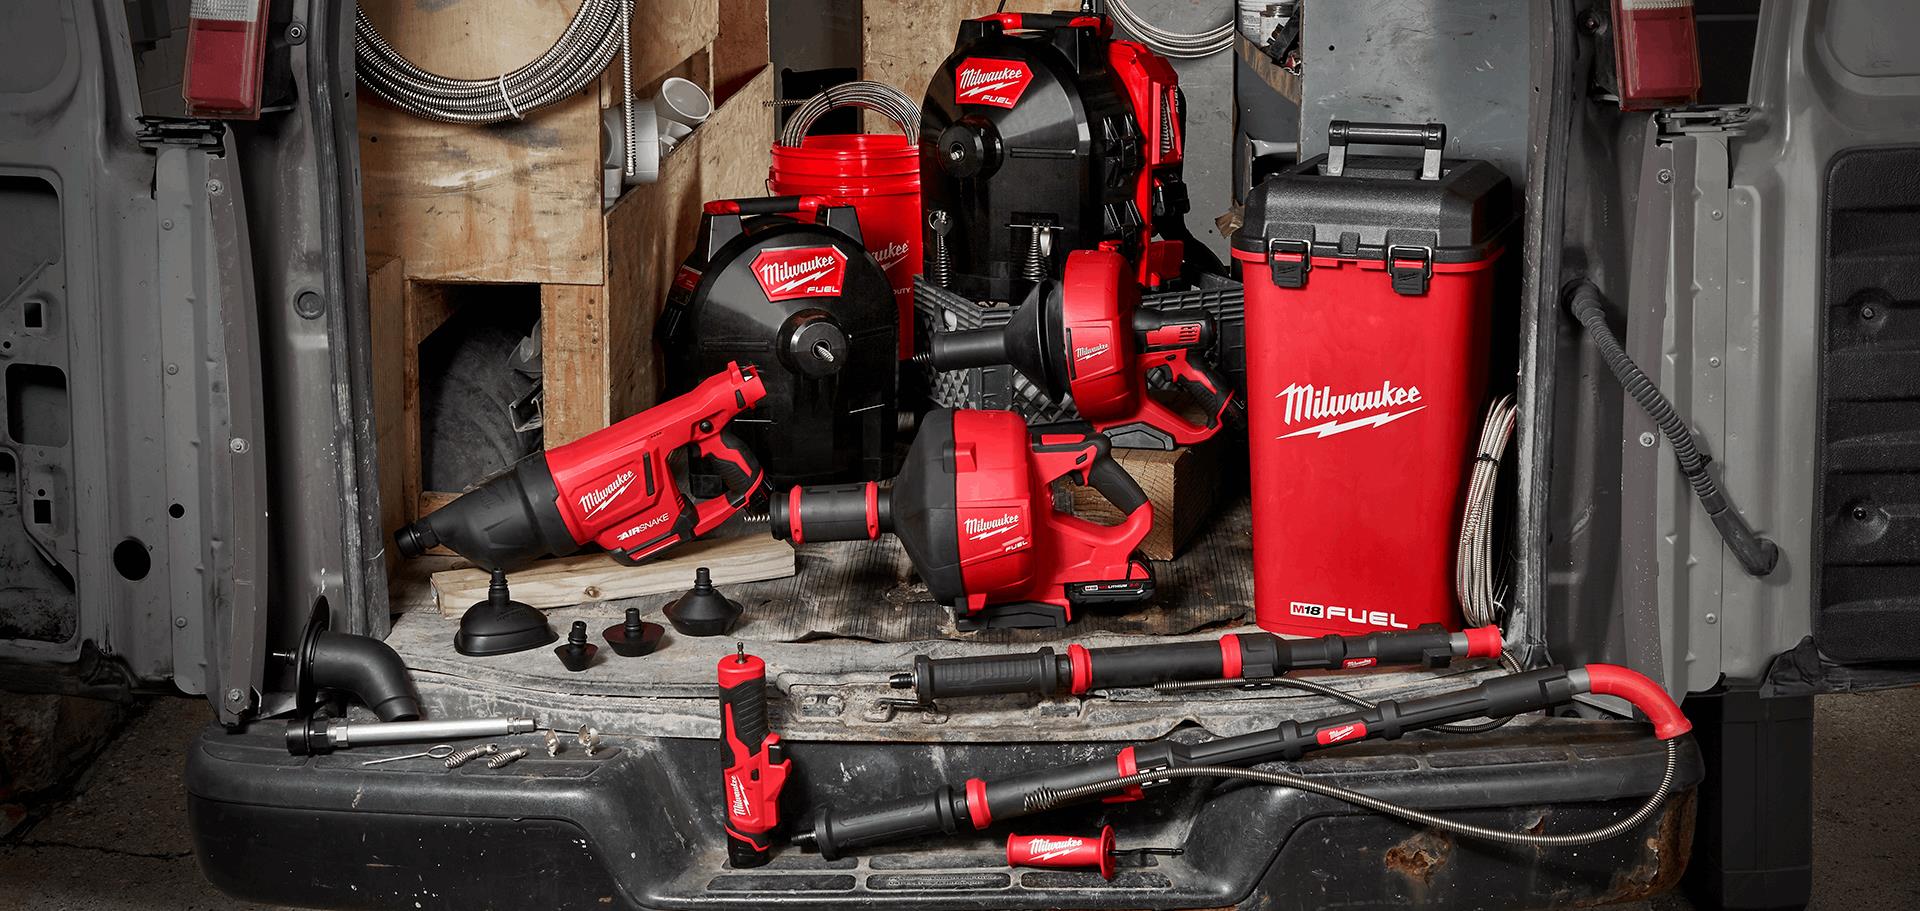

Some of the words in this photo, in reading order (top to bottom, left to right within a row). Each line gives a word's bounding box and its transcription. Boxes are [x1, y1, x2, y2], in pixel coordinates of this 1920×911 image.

[960, 67, 1022, 89] Milwaukee
[981, 94, 1012, 105] FUEL
[760, 256, 835, 286] Milwaukee
[1275, 380, 1422, 426] Milwaukee
[578, 470, 634, 513] Milwaukee
[964, 513, 1019, 535] Milwaukee
[1005, 540, 1028, 553] FUEL
[1292, 604, 1322, 616] M18
[1326, 606, 1408, 629] FUEL
[730, 775, 746, 817] Milwaukee
[1028, 837, 1083, 855] Milwaukee
